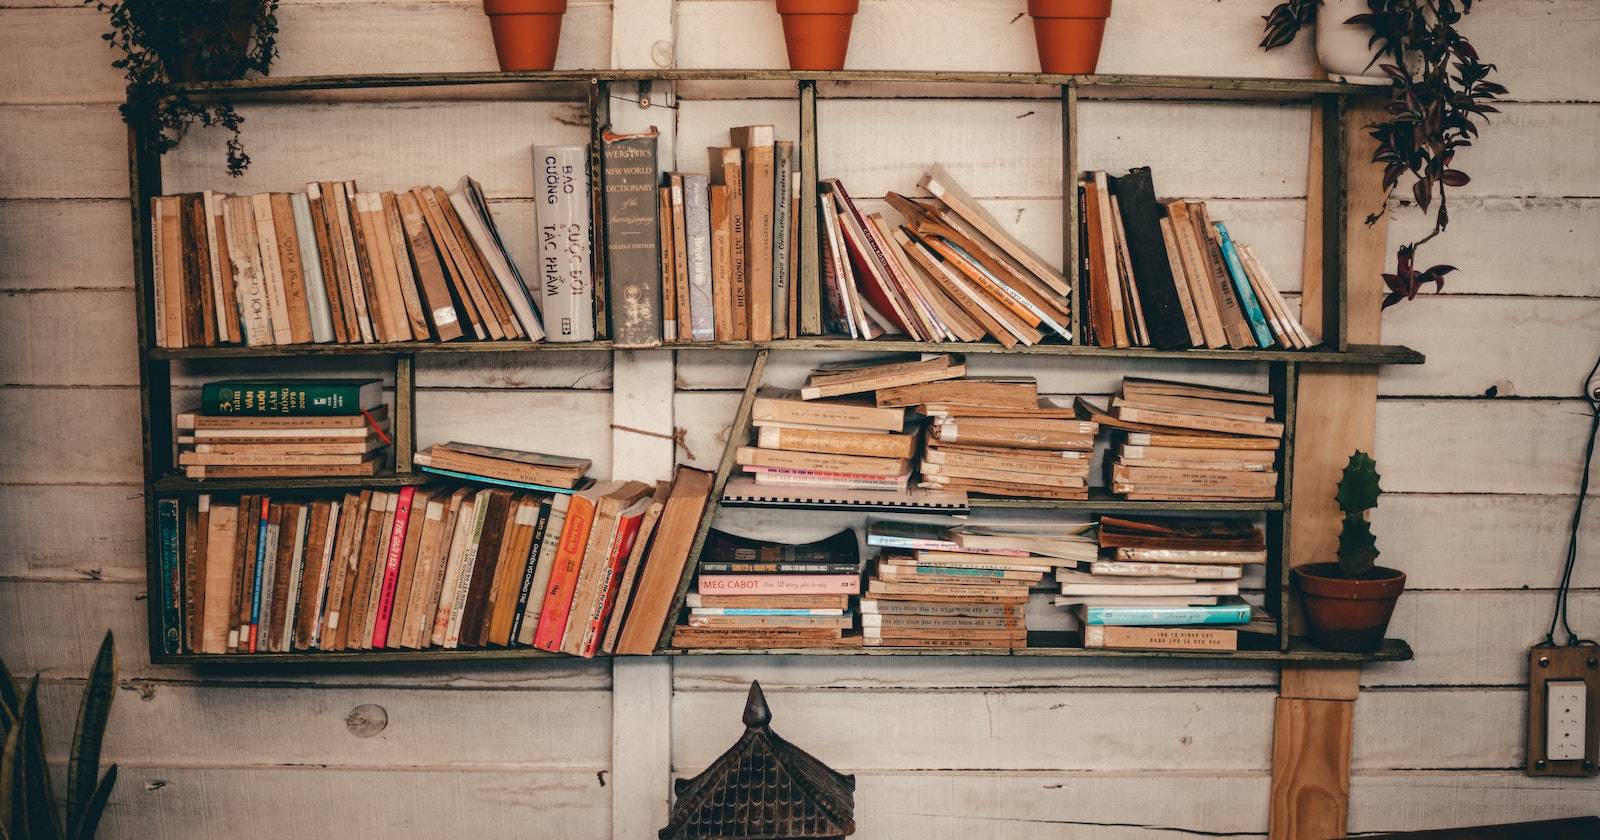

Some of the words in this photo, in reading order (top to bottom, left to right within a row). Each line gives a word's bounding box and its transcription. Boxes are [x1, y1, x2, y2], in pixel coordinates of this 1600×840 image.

[605, 148, 652, 159] WEBSTER'S
[606, 167, 622, 176] NEW
[623, 167, 652, 175] WORLD
[606, 184, 652, 192] DICTIONARY
[245, 391, 254, 409] VĂN
[257, 390, 266, 411] XUÔI
[270, 391, 278, 410] LÂM
[527, 565, 533, 573] VỢ
[604, 568, 612, 584] Quan
[703, 580, 725, 589] MEG
[727, 580, 760, 589] CABOT
